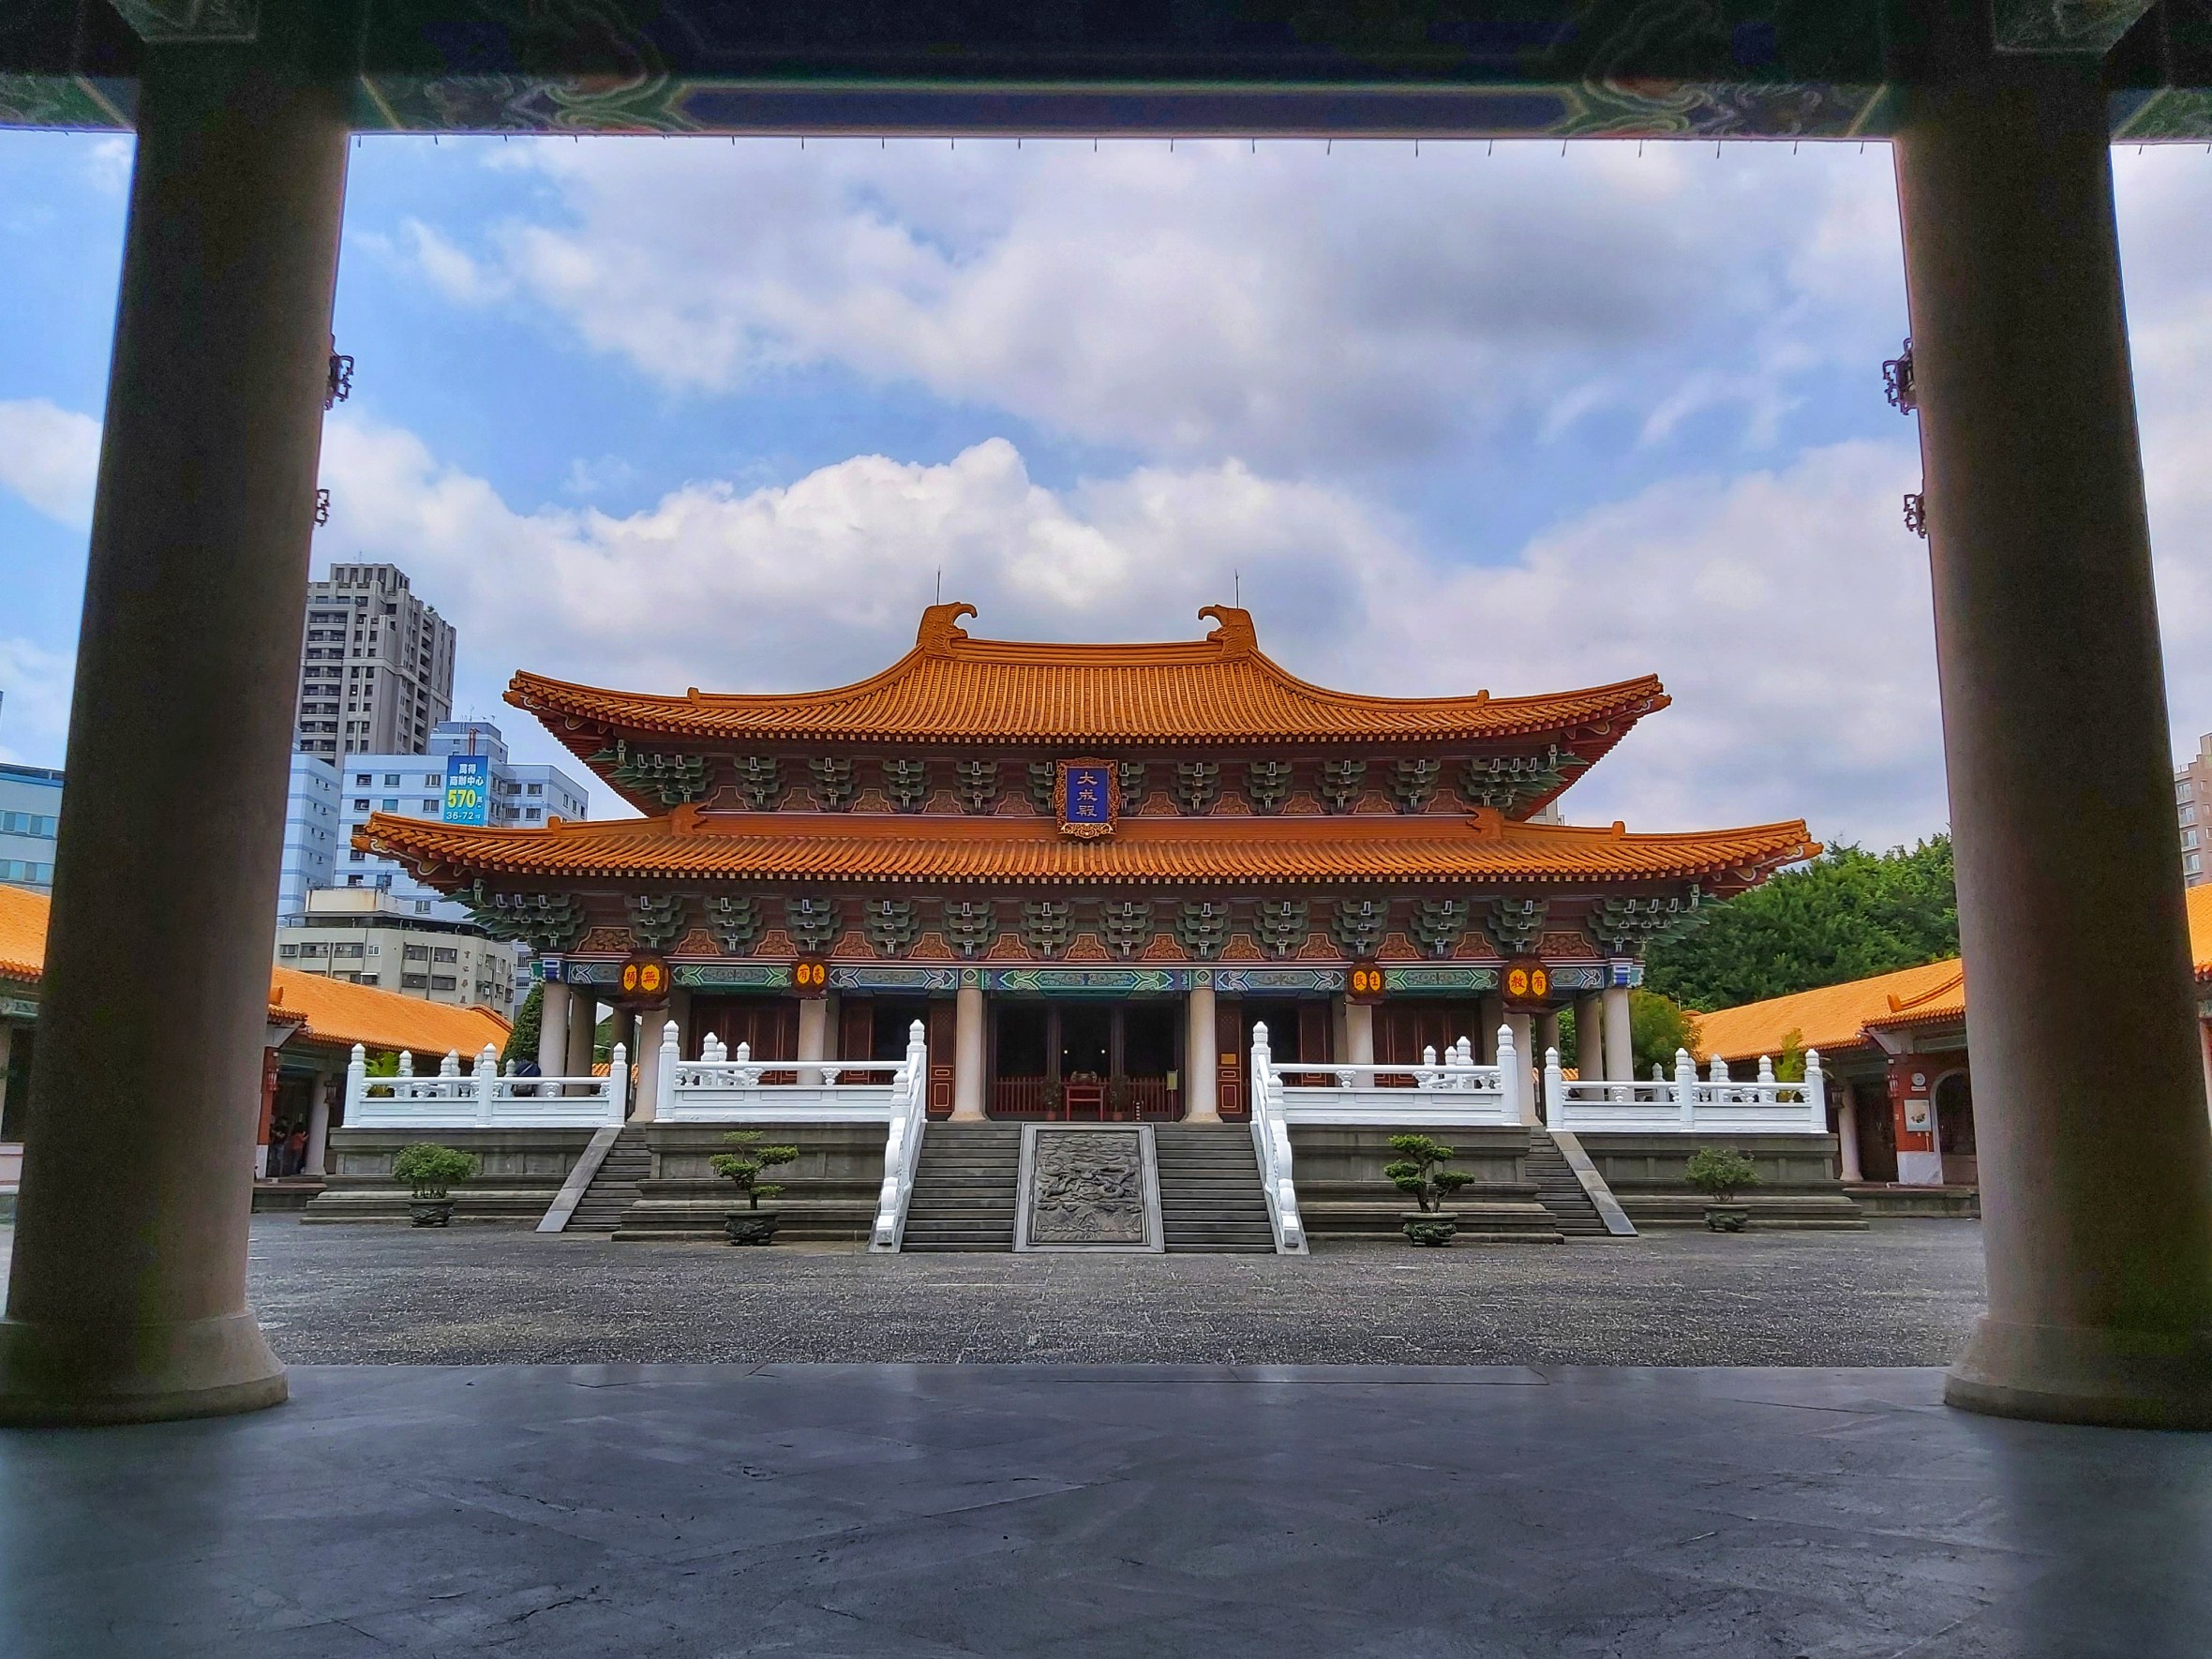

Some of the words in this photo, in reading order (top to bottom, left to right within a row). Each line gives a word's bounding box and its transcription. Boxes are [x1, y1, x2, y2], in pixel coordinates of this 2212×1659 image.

[447, 789, 476, 808] 570
[1075, 770, 1098, 817] 大成殿
